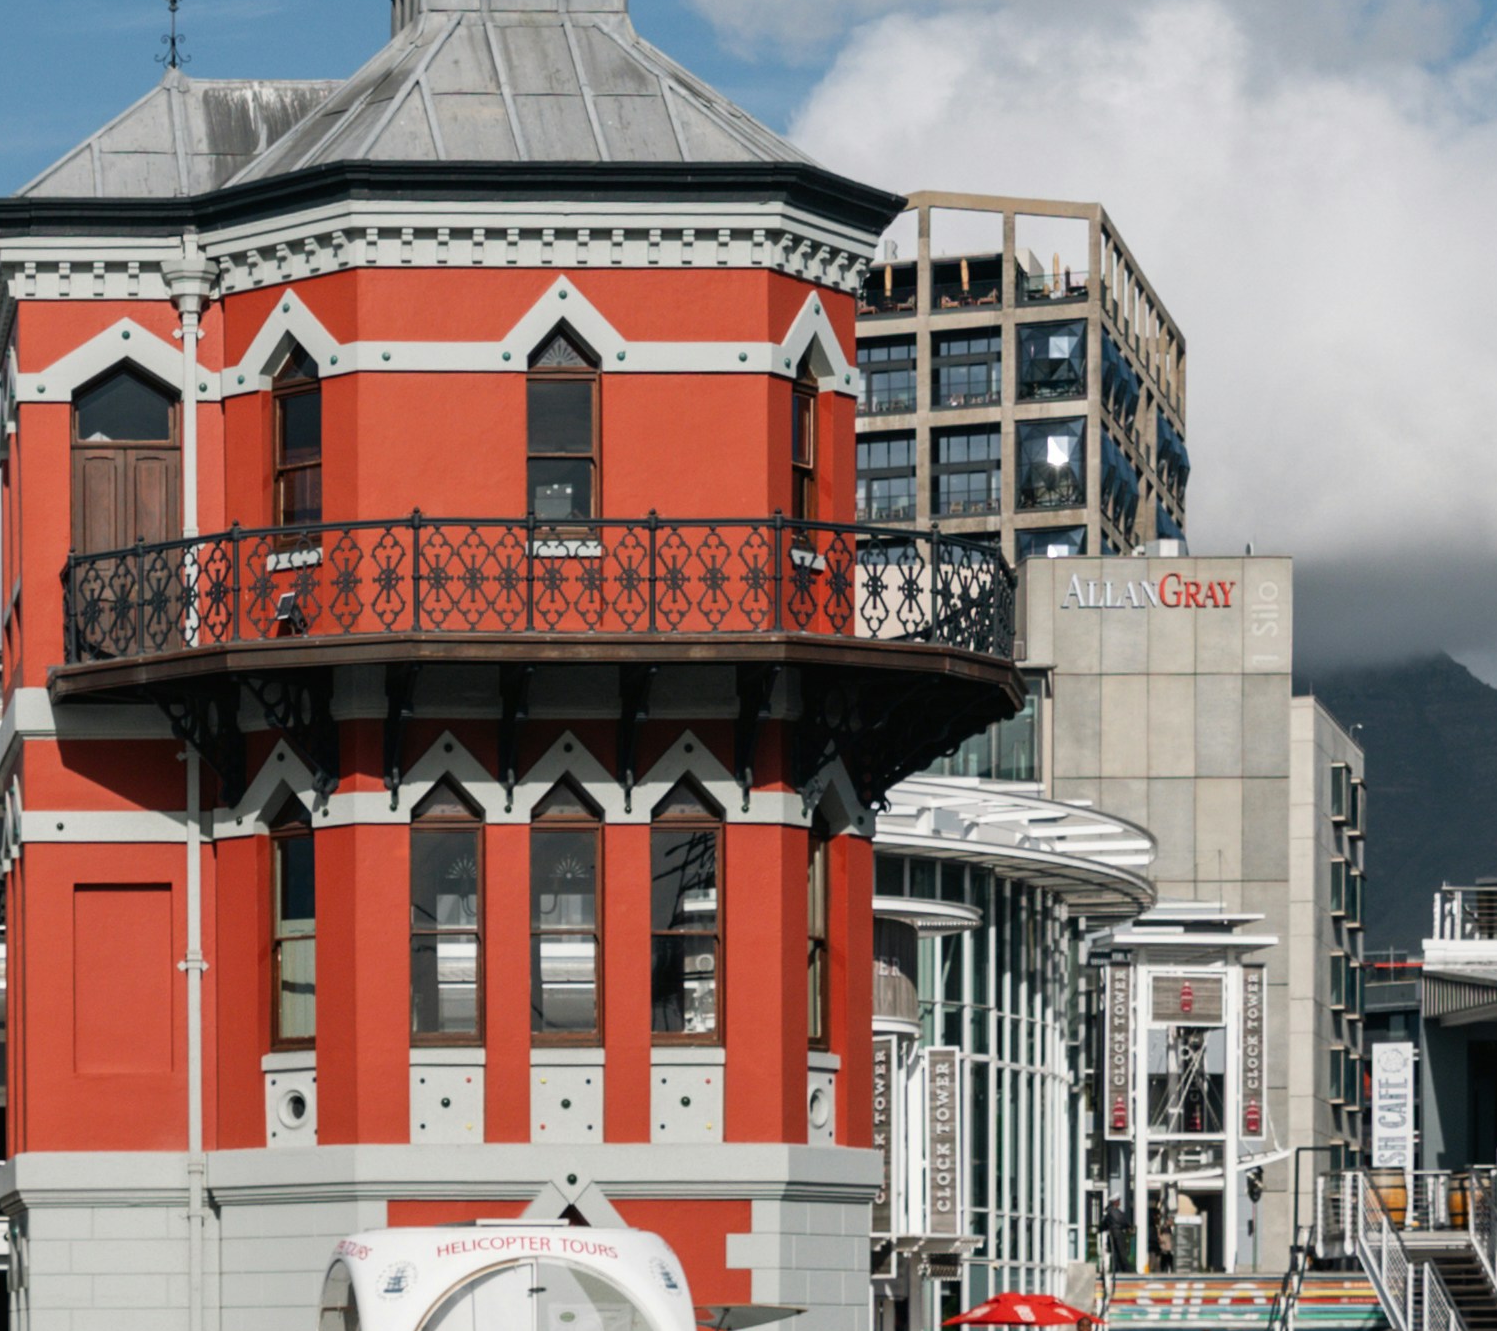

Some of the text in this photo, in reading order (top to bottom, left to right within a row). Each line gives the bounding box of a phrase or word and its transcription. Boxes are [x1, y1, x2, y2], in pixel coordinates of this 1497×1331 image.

[1252, 580, 1280, 638] Silo
[1114, 969, 1126, 1086] CLOCK TOWER
[1247, 973, 1259, 1089] CLOCK TOWER
[874, 1049, 886, 1124] TOWER
[1378, 1078, 1408, 1129] CAFE
[936, 1062, 951, 1213] CLOCK TOWER
[436, 1235, 619, 1259] HELICOPTER TOURS
